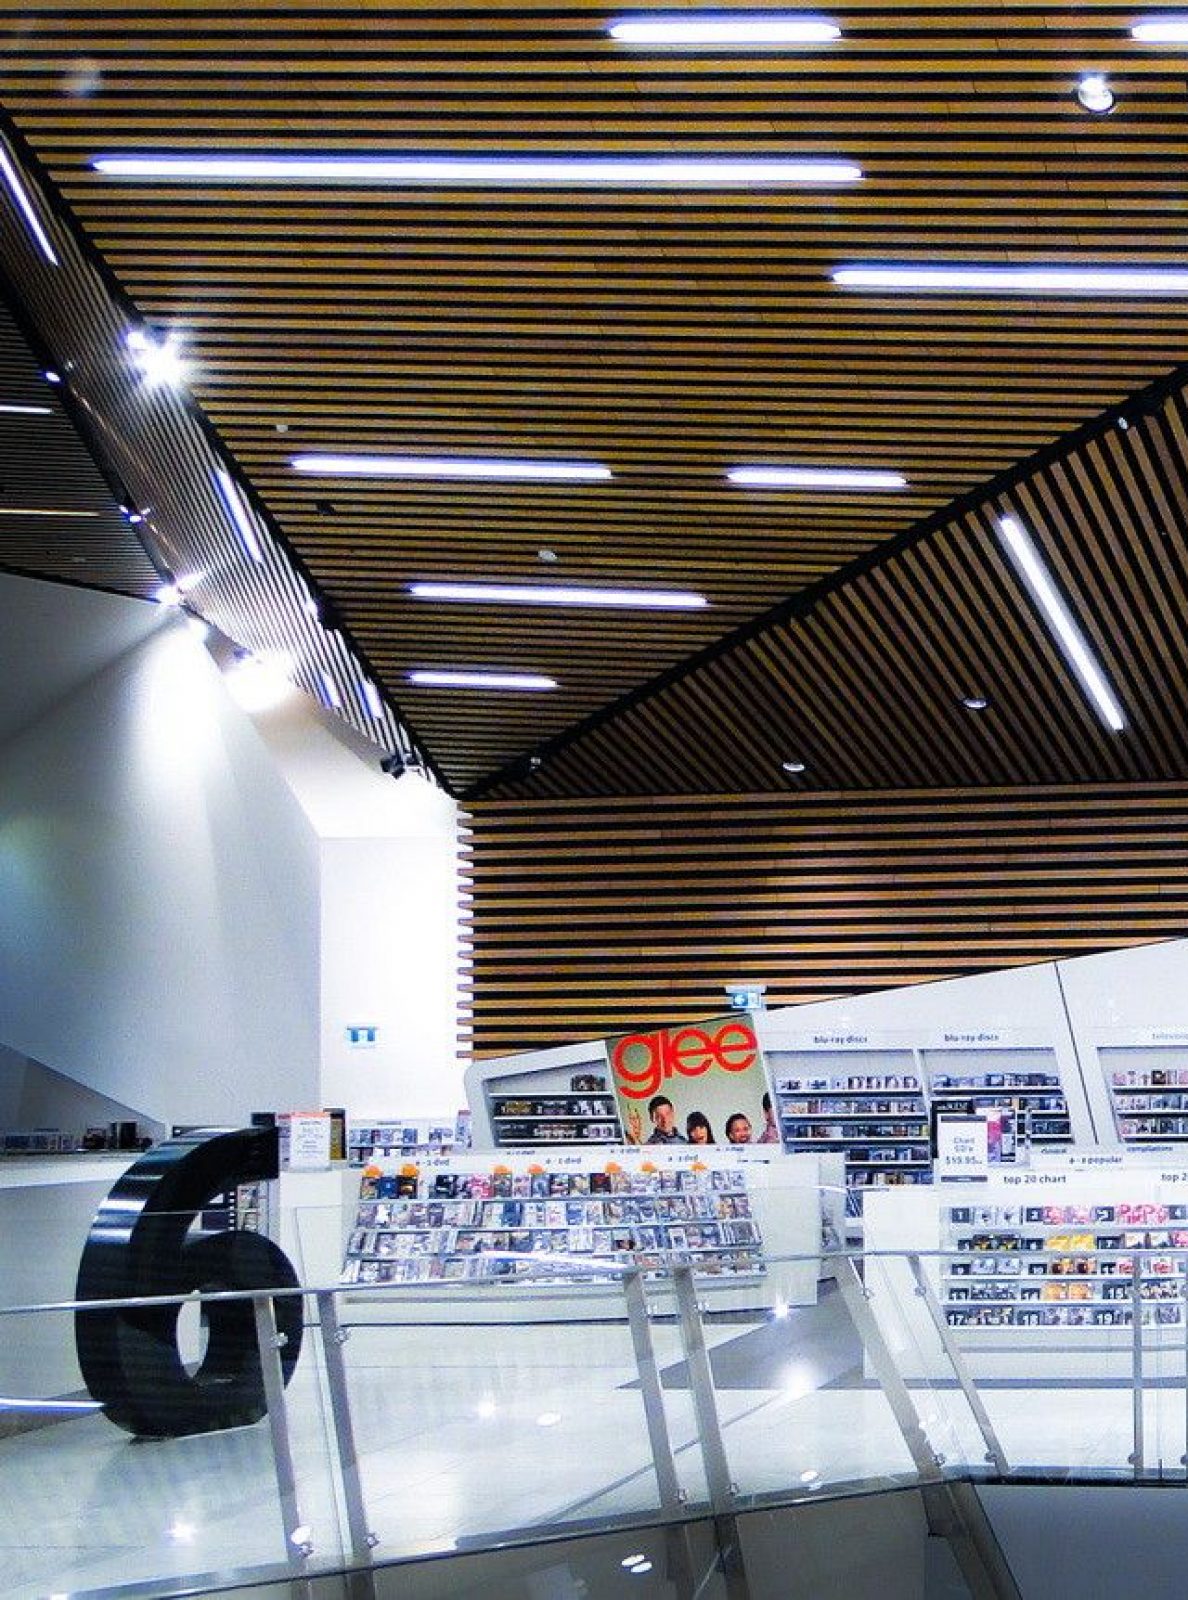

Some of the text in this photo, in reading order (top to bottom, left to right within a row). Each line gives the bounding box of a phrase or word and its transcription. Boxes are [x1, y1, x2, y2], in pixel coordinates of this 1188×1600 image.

[814, 1036, 868, 1045] blu-ray discs
[611, 1022, 758, 1100] glee
[1087, 1156, 1122, 1165] popular
[1003, 1174, 1067, 1185] top 20 chart
[1161, 1172, 1180, 1183] top
